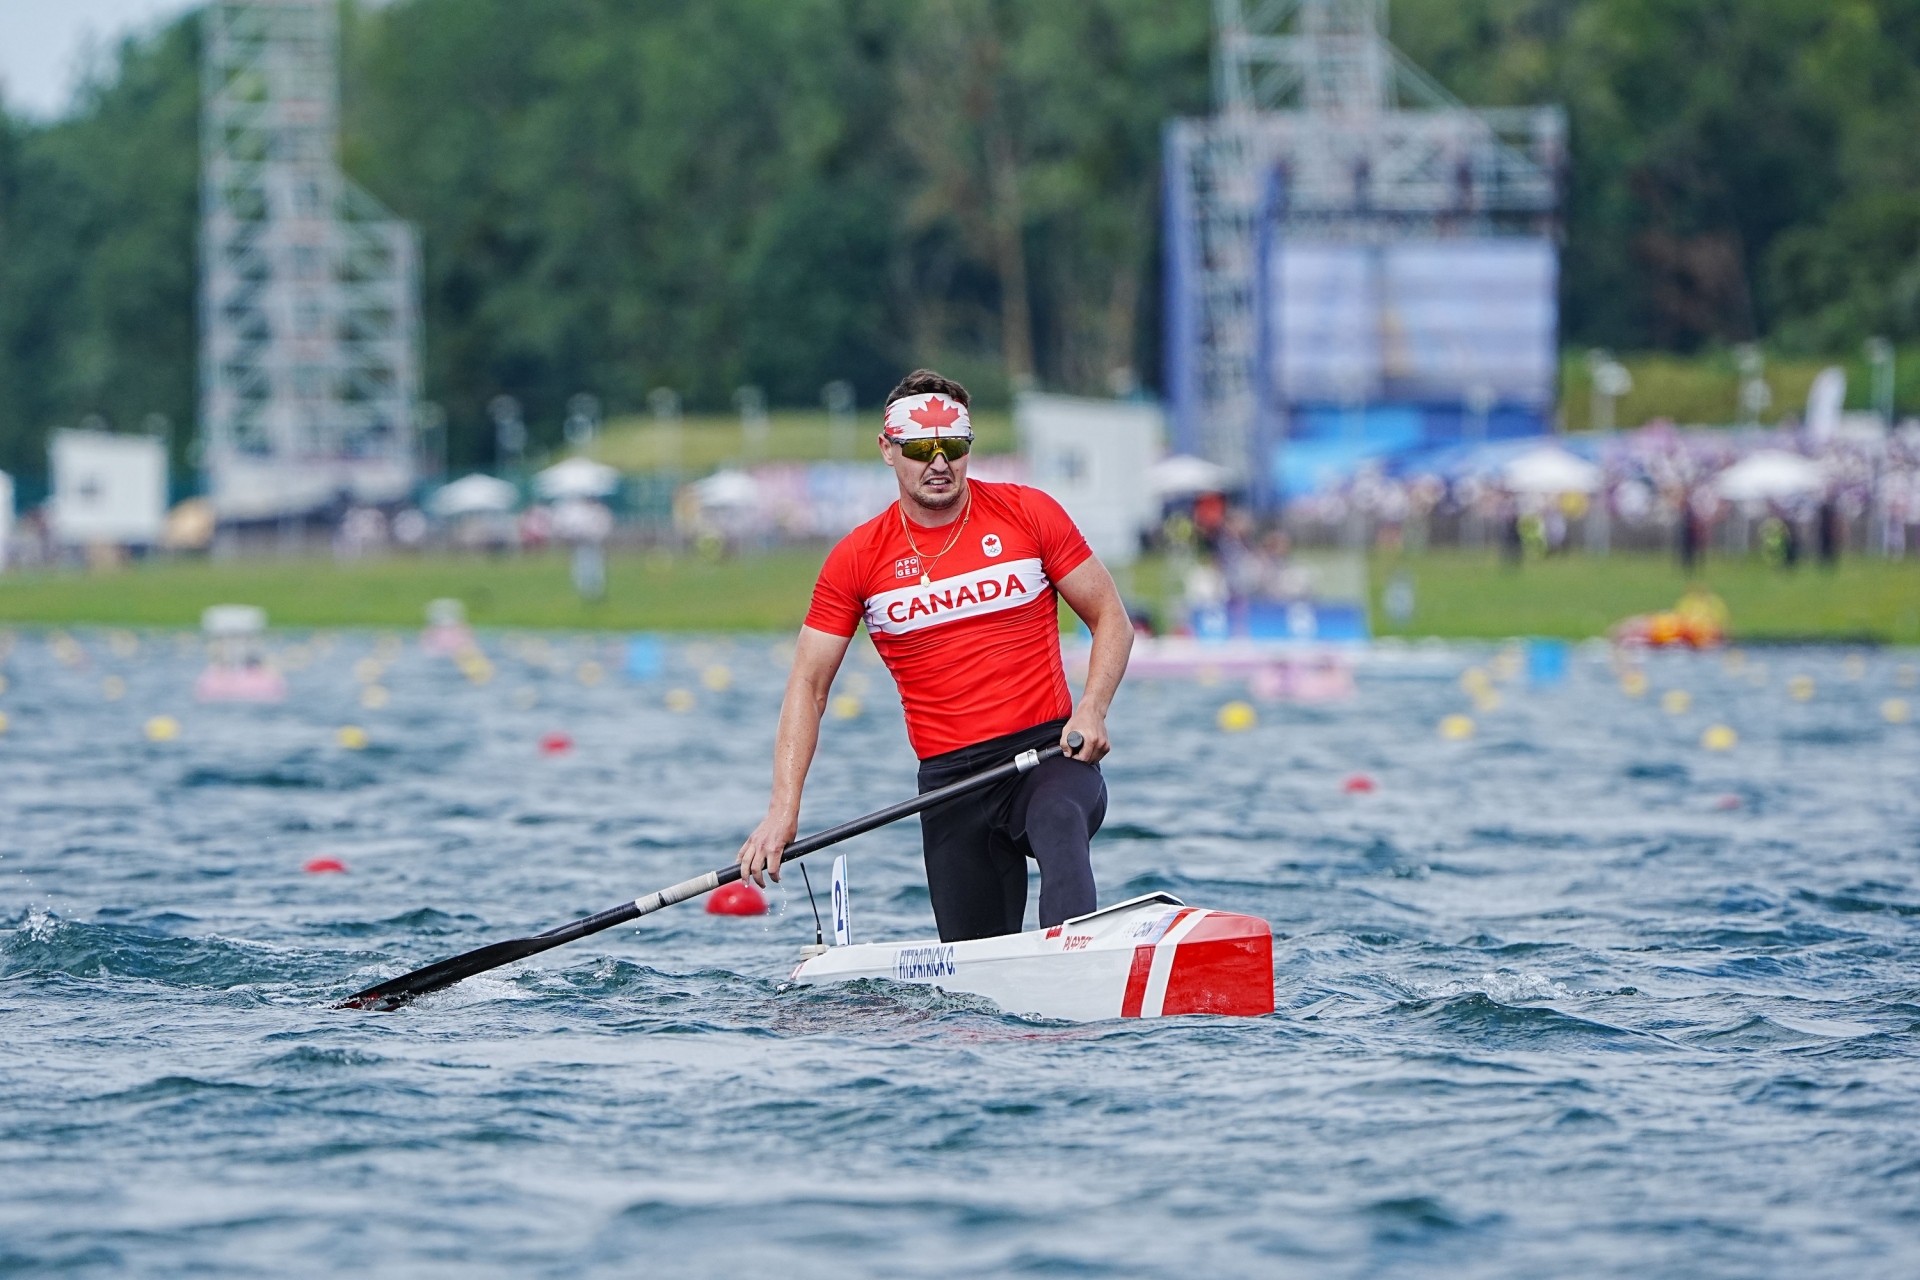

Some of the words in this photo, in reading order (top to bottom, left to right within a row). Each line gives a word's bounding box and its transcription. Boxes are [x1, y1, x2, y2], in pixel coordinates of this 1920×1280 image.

[897, 558, 917, 567] APO
[886, 573, 1027, 624] CANADA
[835, 880, 844, 932] 2
